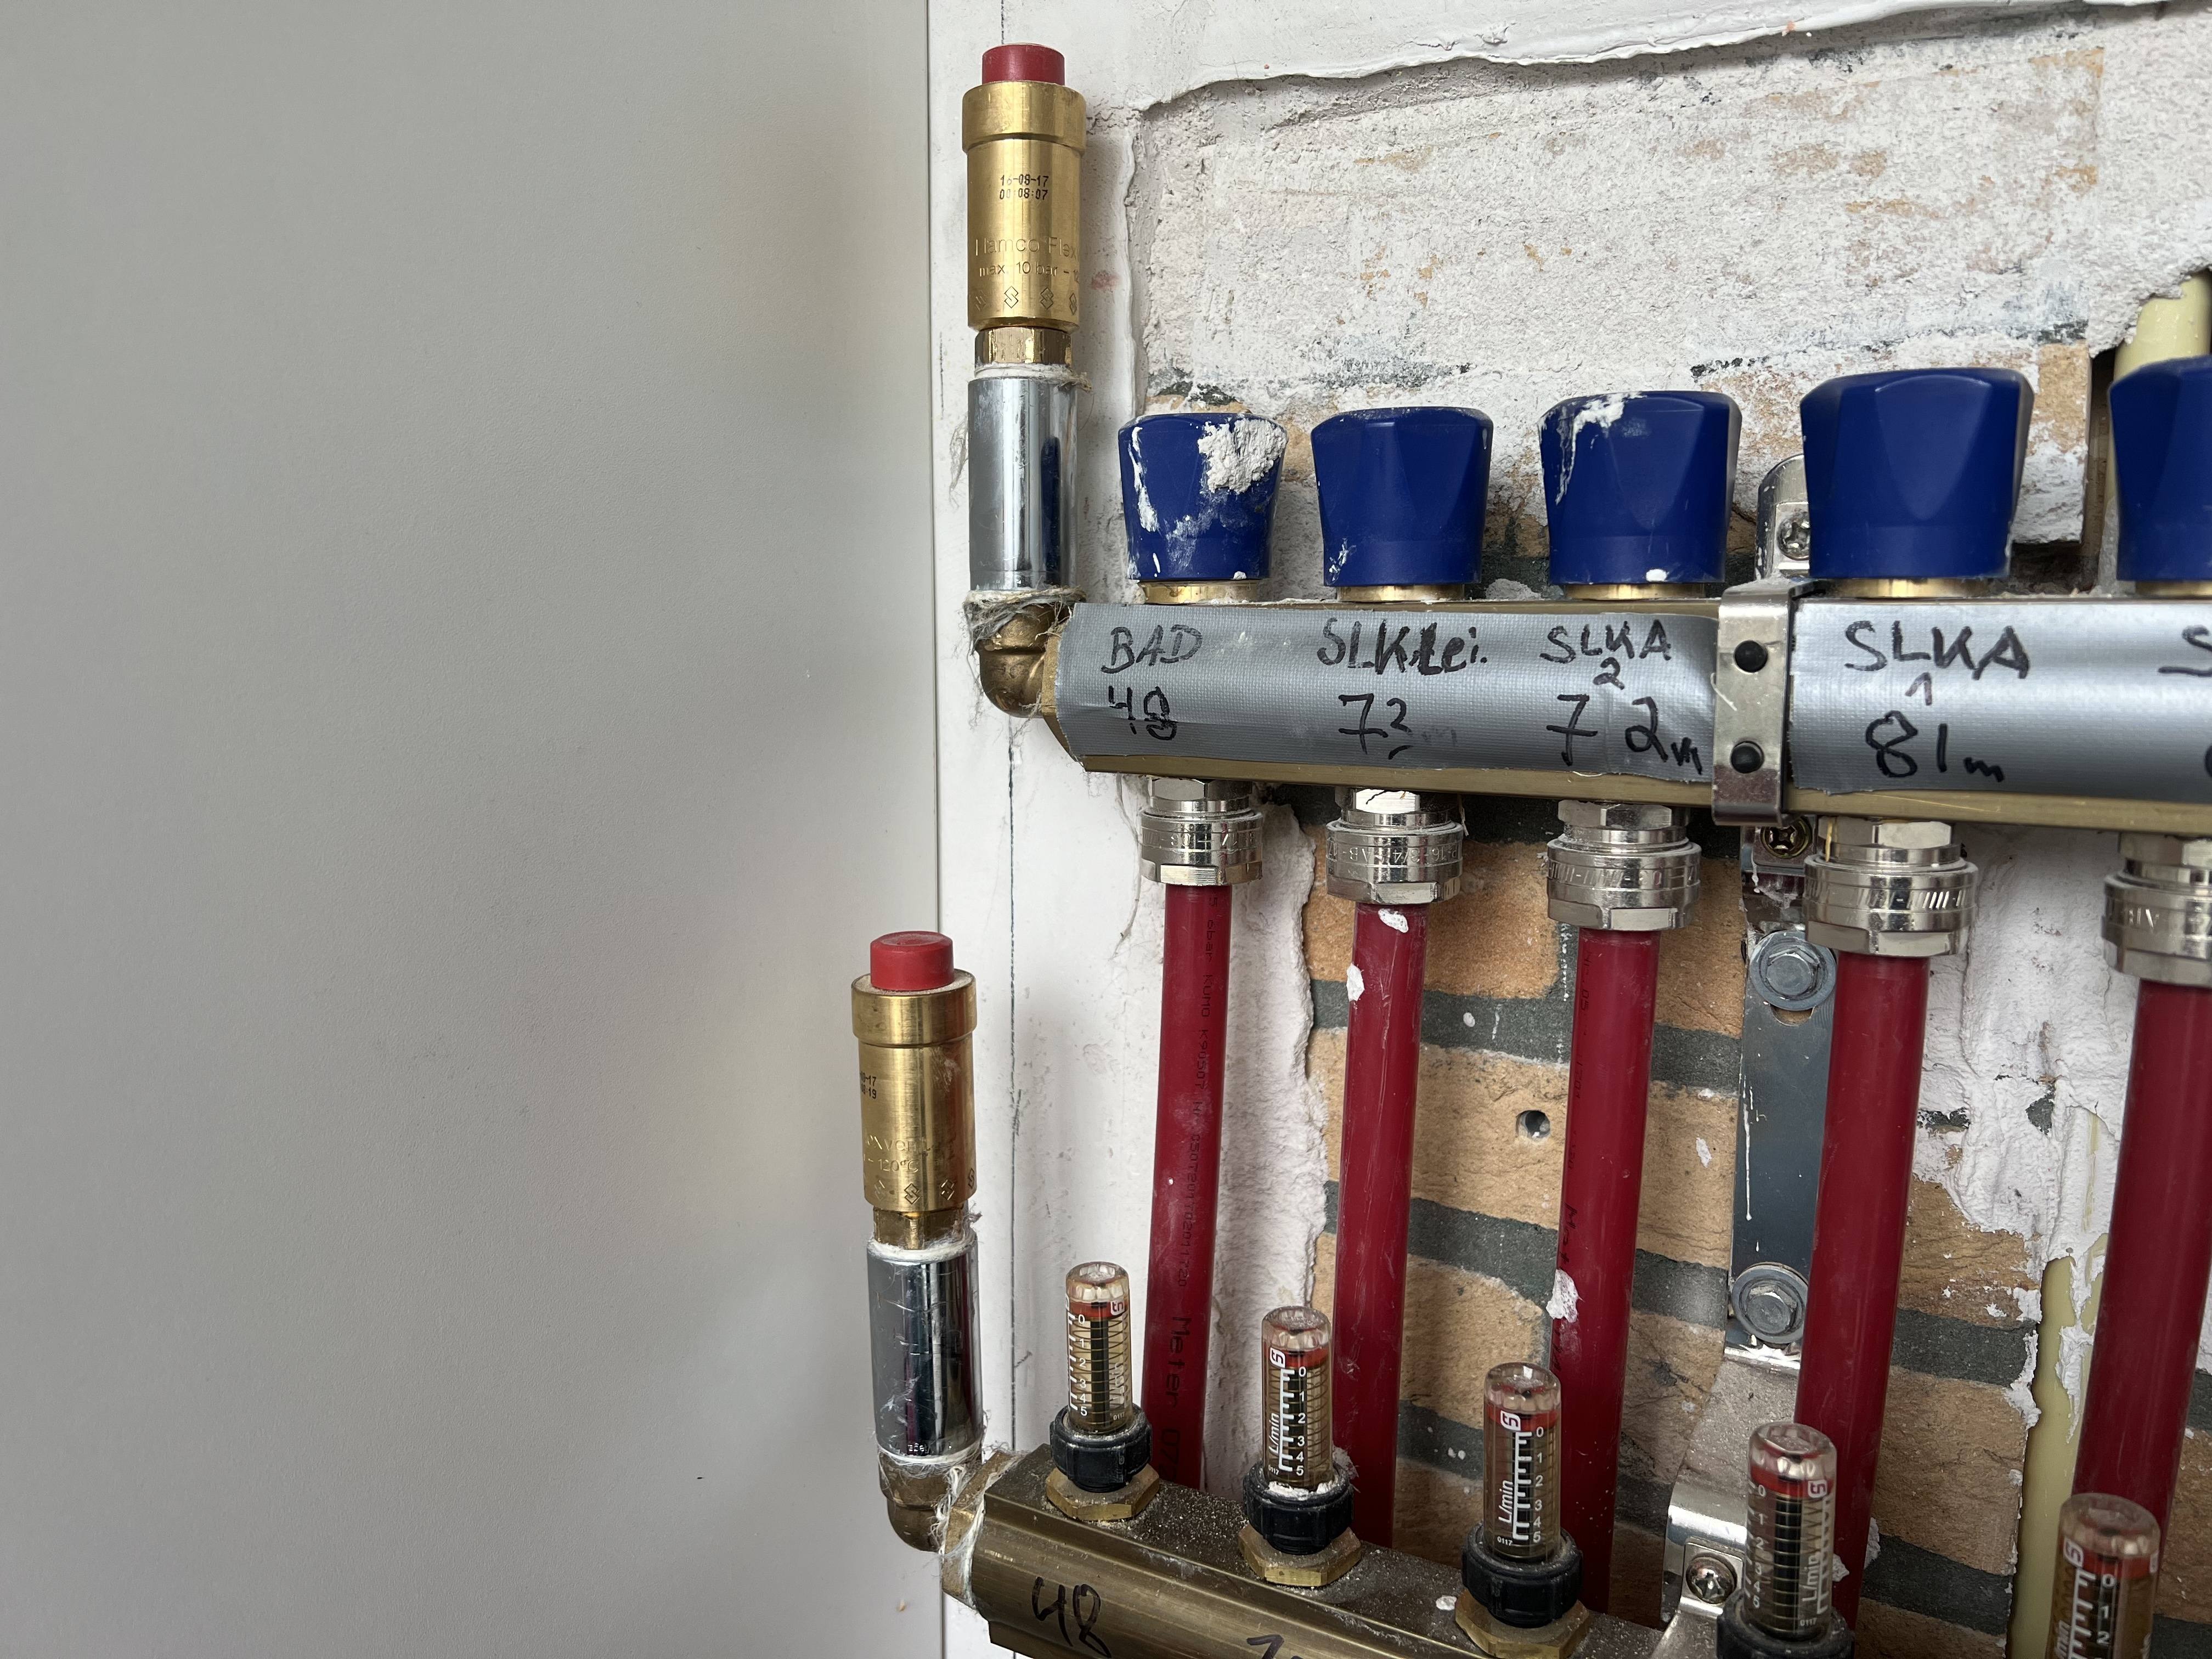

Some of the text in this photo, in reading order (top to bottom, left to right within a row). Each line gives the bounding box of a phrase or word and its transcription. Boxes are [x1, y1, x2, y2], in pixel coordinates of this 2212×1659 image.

[1016, 261, 1031, 275] 10
[1036, 261, 1058, 276] bar
[1101, 623, 1203, 674] BAD
[1539, 618, 1672, 663] SLKA
[1844, 620, 2030, 681] SLKA
[1593, 656, 1625, 690] 2
[1905, 672, 1933, 706] 1
[1200, 974, 1214, 1018] KUMO
[1078, 1314, 1086, 1324] 0
[1079, 1338, 1085, 1348] 1
[1079, 1358, 1086, 1368] 2
[1165, 1316, 1192, 1409] Meter
[1298, 1366, 1307, 1378] 0
[1079, 1379, 1087, 1389] 3
[1079, 1393, 1086, 1404] 4
[1299, 1391, 1305, 1402] 1
[1080, 1406, 1088, 1417] 5
[1297, 1413, 1306, 1424] 2
[1268, 1413, 1279, 1454] L/min
[1536, 1426, 1544, 1438] 0
[1297, 1435, 1305, 1447] 3
[1295, 1451, 1305, 1463] 4
[1537, 1452, 1543, 1463] 1
[1296, 1464, 1305, 1476] 5
[1535, 1475, 1544, 1487] 2
[1758, 1484, 1767, 1497] 0
[1498, 1480, 1514, 1523] L/min
[1534, 1499, 1543, 1511] 3
[1533, 1516, 1542, 1528] 4
[1757, 1513, 1765, 1526] 1
[1533, 1531, 1542, 1544] 5
[1755, 1536, 1765, 1550] 2
[1754, 1561, 1763, 1576] 3
[1753, 1578, 1761, 1593] 4
[2102, 1573, 2115, 1588] 0
[1752, 1594, 1760, 1609] 5
[2101, 1605, 2109, 1619] 1
[2096, 1630, 2111, 1646] 2
